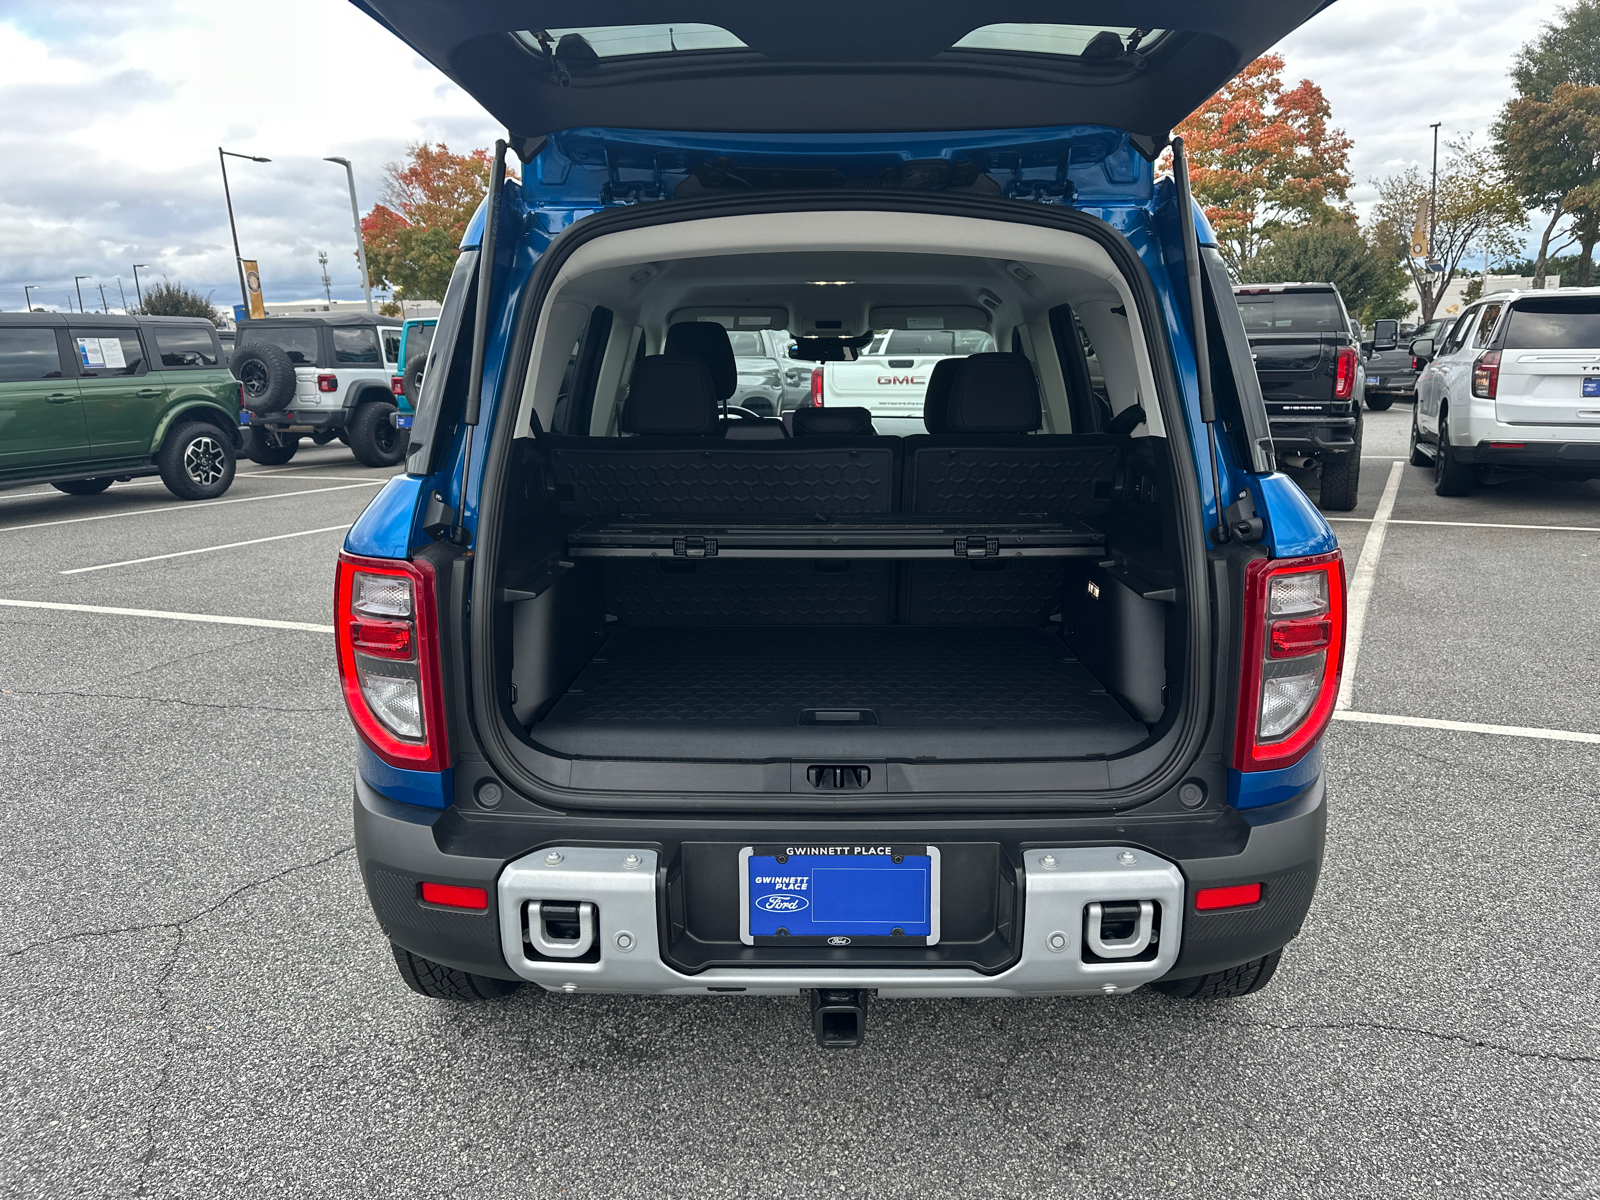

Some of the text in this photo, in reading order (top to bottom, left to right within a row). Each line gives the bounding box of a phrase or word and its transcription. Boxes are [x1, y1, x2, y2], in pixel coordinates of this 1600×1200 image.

[877, 376, 926, 385] GMC
[786, 847, 892, 855] GWINNETT PLACE
[755, 876, 809, 884] GWINNETT
[765, 896, 799, 910] Ford
